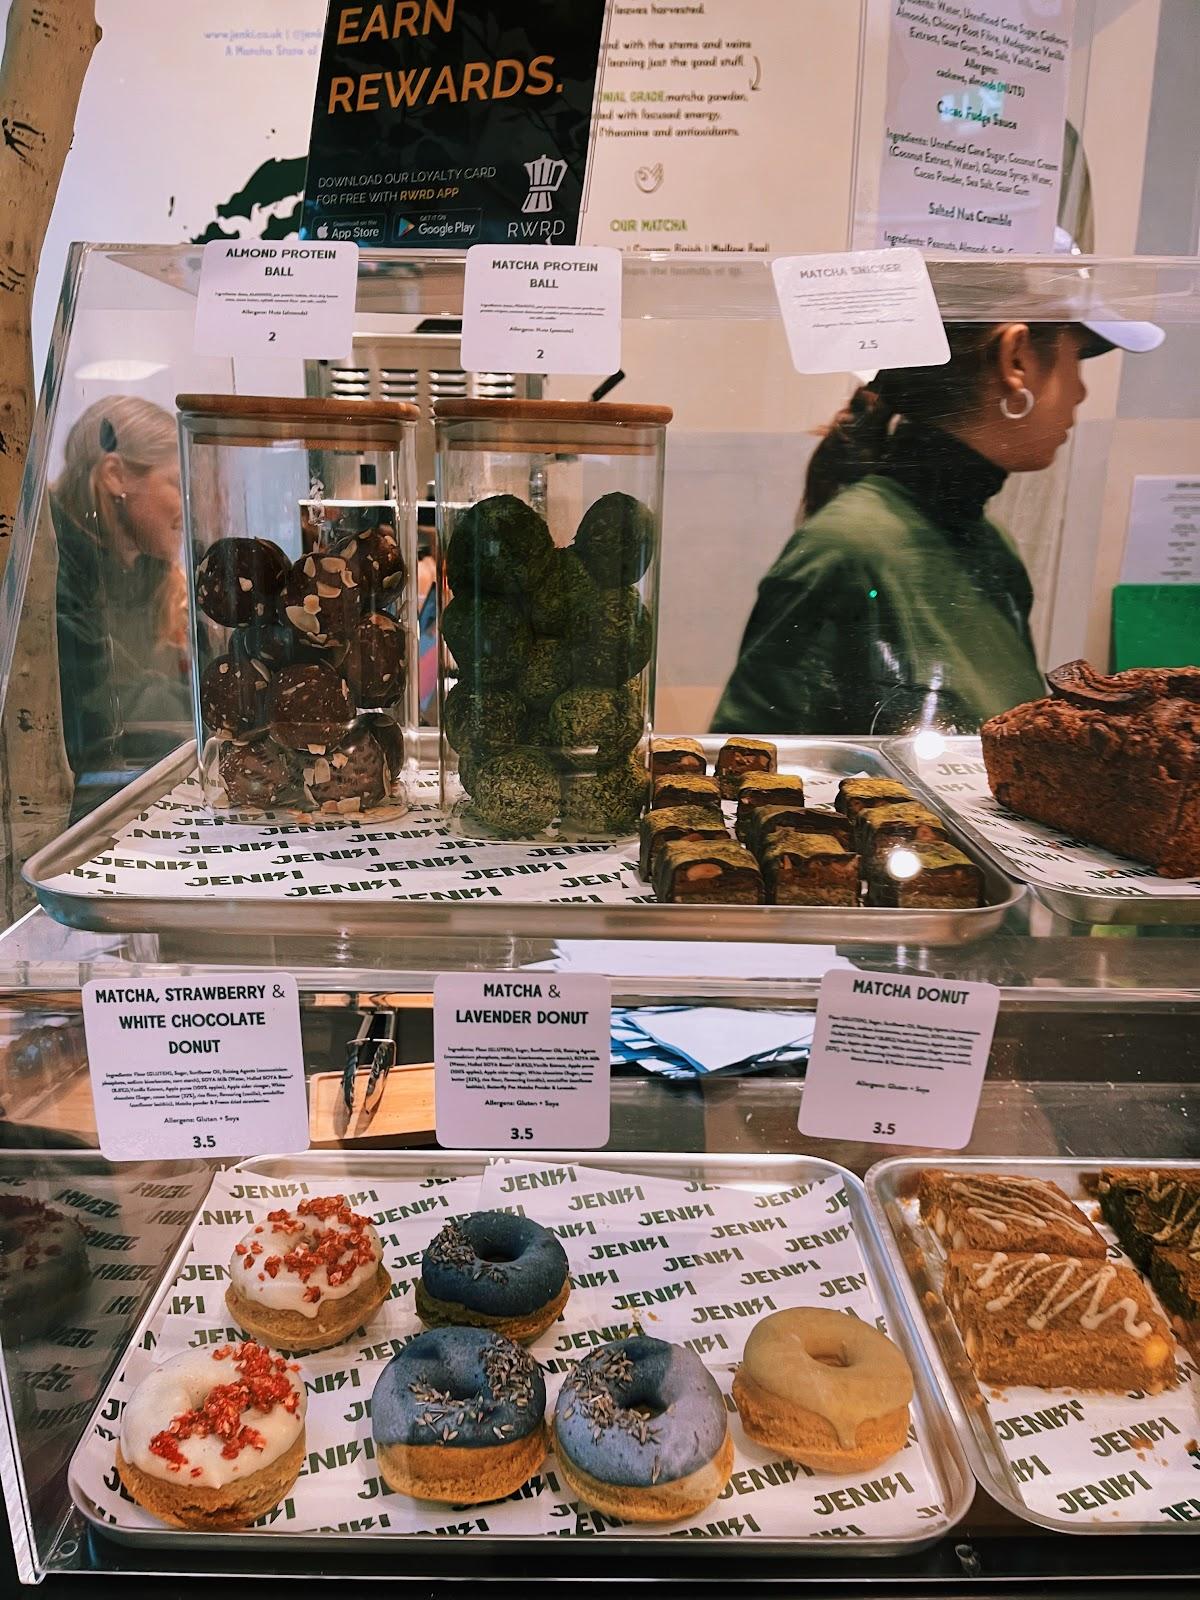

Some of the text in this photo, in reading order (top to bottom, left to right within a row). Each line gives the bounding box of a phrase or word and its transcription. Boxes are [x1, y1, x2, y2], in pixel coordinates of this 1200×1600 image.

[337, 0, 455, 46] EARN
[327, 55, 564, 115] REWARDS.
[318, 166, 497, 188] DOWNLOAD OUR LOYALTY CARD
[316, 187, 460, 206] FOR FREE WITH RWRD APP
[928, 201, 1012, 227] Salted Nut Crumble
[331, 227, 380, 241] App Store
[418, 222, 476, 237] Google Play
[507, 219, 566, 238] RWRD
[610, 219, 688, 233] OUR MATCHA
[225, 248, 337, 260] ALMOND PROTEIN
[264, 266, 295, 277] BALL
[491, 260, 599, 272] MATCHA PROTEIN
[800, 267, 848, 279] MATCHA
[529, 278, 559, 289] BALL
[267, 331, 277, 342] 2
[536, 349, 545, 359] 2
[179, 840, 289, 855] JENKI
[271, 847, 380, 865] JENKI
[90, 856, 208, 871] JENKI
[364, 855, 474, 873] JENKI
[461, 862, 568, 880] JENKI
[185, 870, 304, 887] JENKI
[284, 878, 402, 897] JENKI
[95, 984, 286, 1004] MATCHA, STRAWBERRY &
[483, 983, 561, 999] MATCHA &
[852, 979, 970, 1006] MATCHA DONUT
[119, 1012, 266, 1029] WHITE CHOCOLATE
[456, 1009, 589, 1025] LAVENDER DONUT
[168, 1039, 220, 1054] DONUT
[510, 1127, 534, 1141] 3.5
[872, 1122, 896, 1136] 3.5
[192, 1135, 217, 1149] 3.5
[500, 1167, 577, 1193] JENKI
[229, 1182, 310, 1199] JENKI
[568, 1186, 645, 1211] JENKI
[637, 1203, 715, 1226] JENKI
[710, 1217, 788, 1239] JENKI
[588, 1236, 669, 1260] JENKI
[662, 1247, 745, 1272] JENKI
[740, 1260, 821, 1285] JENKI
[611, 1280, 697, 1311] JENKI
[691, 1295, 777, 1324] JENKI
[994, 1400, 1085, 1441] JENKI
[1090, 1416, 1181, 1457] JENKI
[813, 1472, 915, 1515] JENKI
[1056, 1470, 1153, 1514] JENKI
